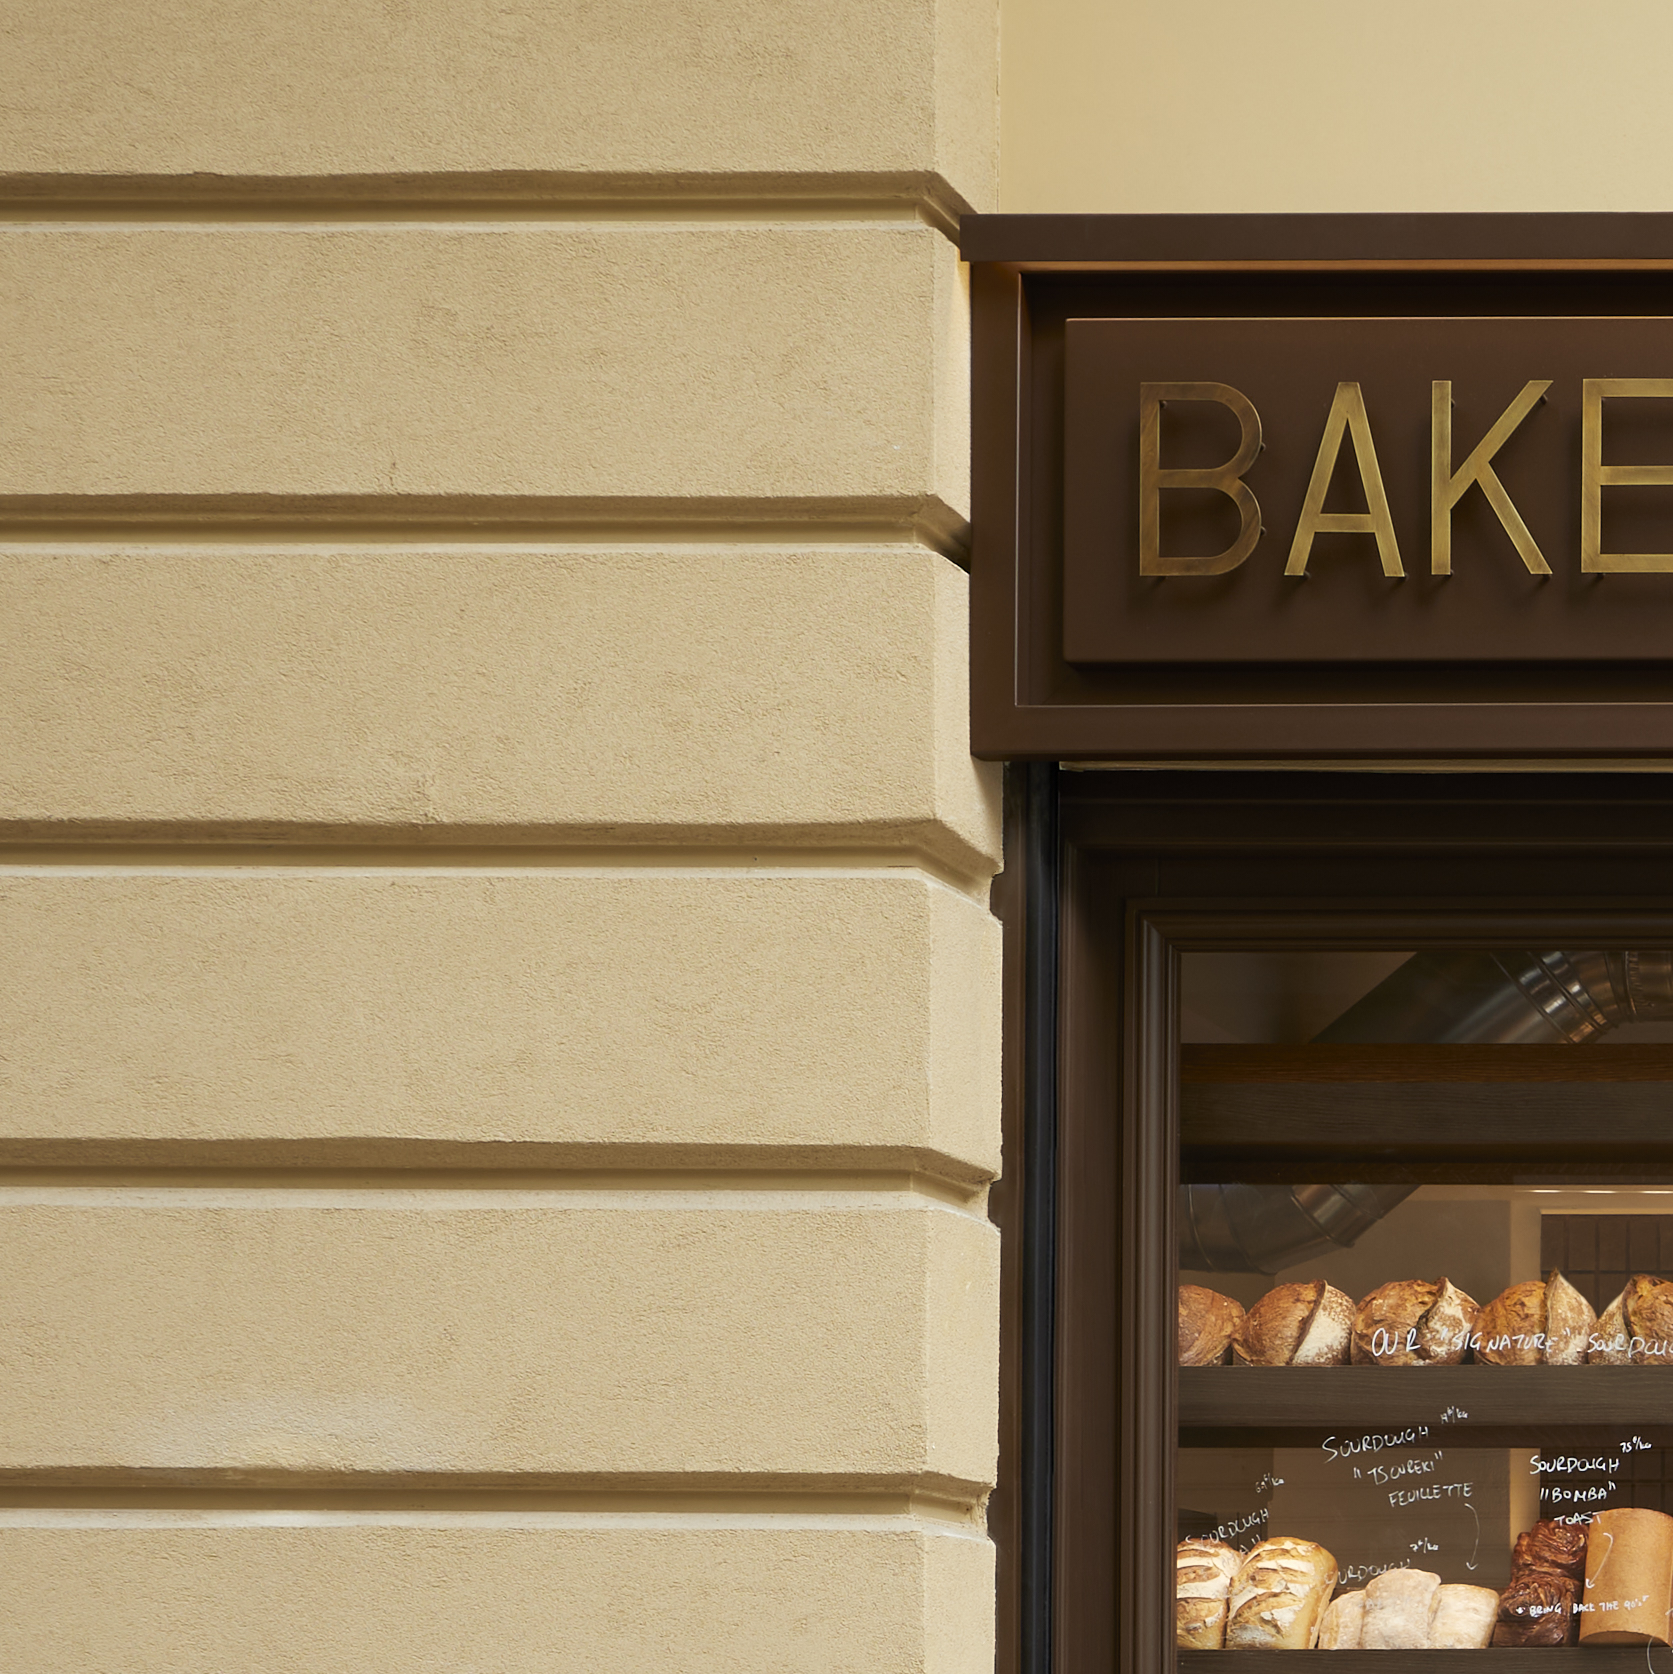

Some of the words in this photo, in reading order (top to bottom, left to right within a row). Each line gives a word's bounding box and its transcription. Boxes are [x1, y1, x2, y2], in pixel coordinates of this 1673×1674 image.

[1371, 1327, 1421, 1356] OUR
[1322, 1426, 1430, 1464] SOURDOUGH
[1529, 1455, 1621, 1476] SOURDOUGH
[1389, 1482, 1474, 1508] FEUILLETTE
[1554, 1509, 1606, 1527] TOAST
[1529, 1601, 1563, 1618] BRING
[1572, 1602, 1596, 1616] BACK
[1599, 1600, 1619, 1613] THE
